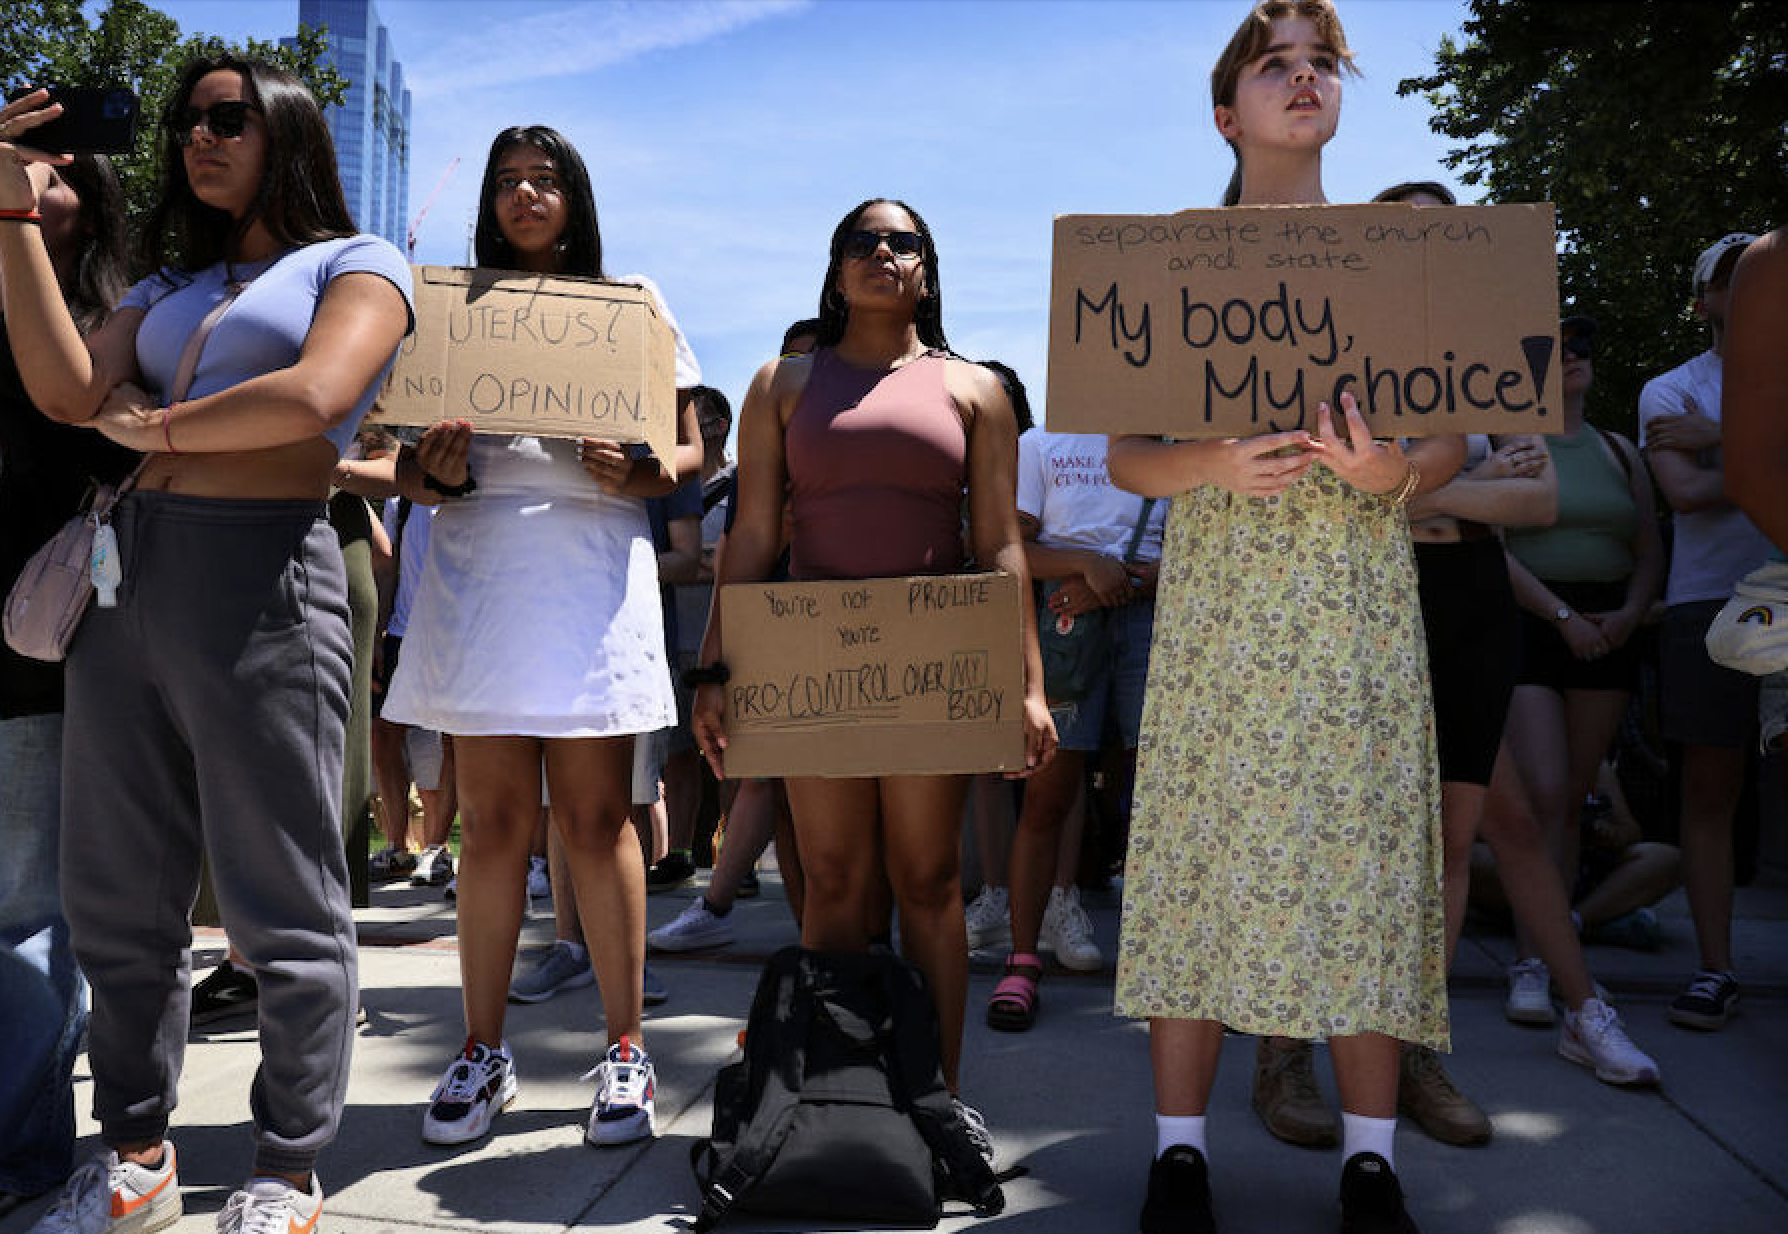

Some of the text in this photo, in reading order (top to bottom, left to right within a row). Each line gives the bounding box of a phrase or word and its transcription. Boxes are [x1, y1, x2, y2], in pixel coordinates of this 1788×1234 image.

[1076, 219, 1491, 253] separate the church
[1167, 246, 1371, 271] and state
[449, 301, 622, 352] UTERUS?
[1076, 282, 1354, 367] My body,
[405, 374, 442, 397] NO
[1205, 336, 1555, 432] My choice!
[842, 587, 872, 609] not
[904, 661, 947, 697] OVER
[948, 689, 1005, 723] BODY
